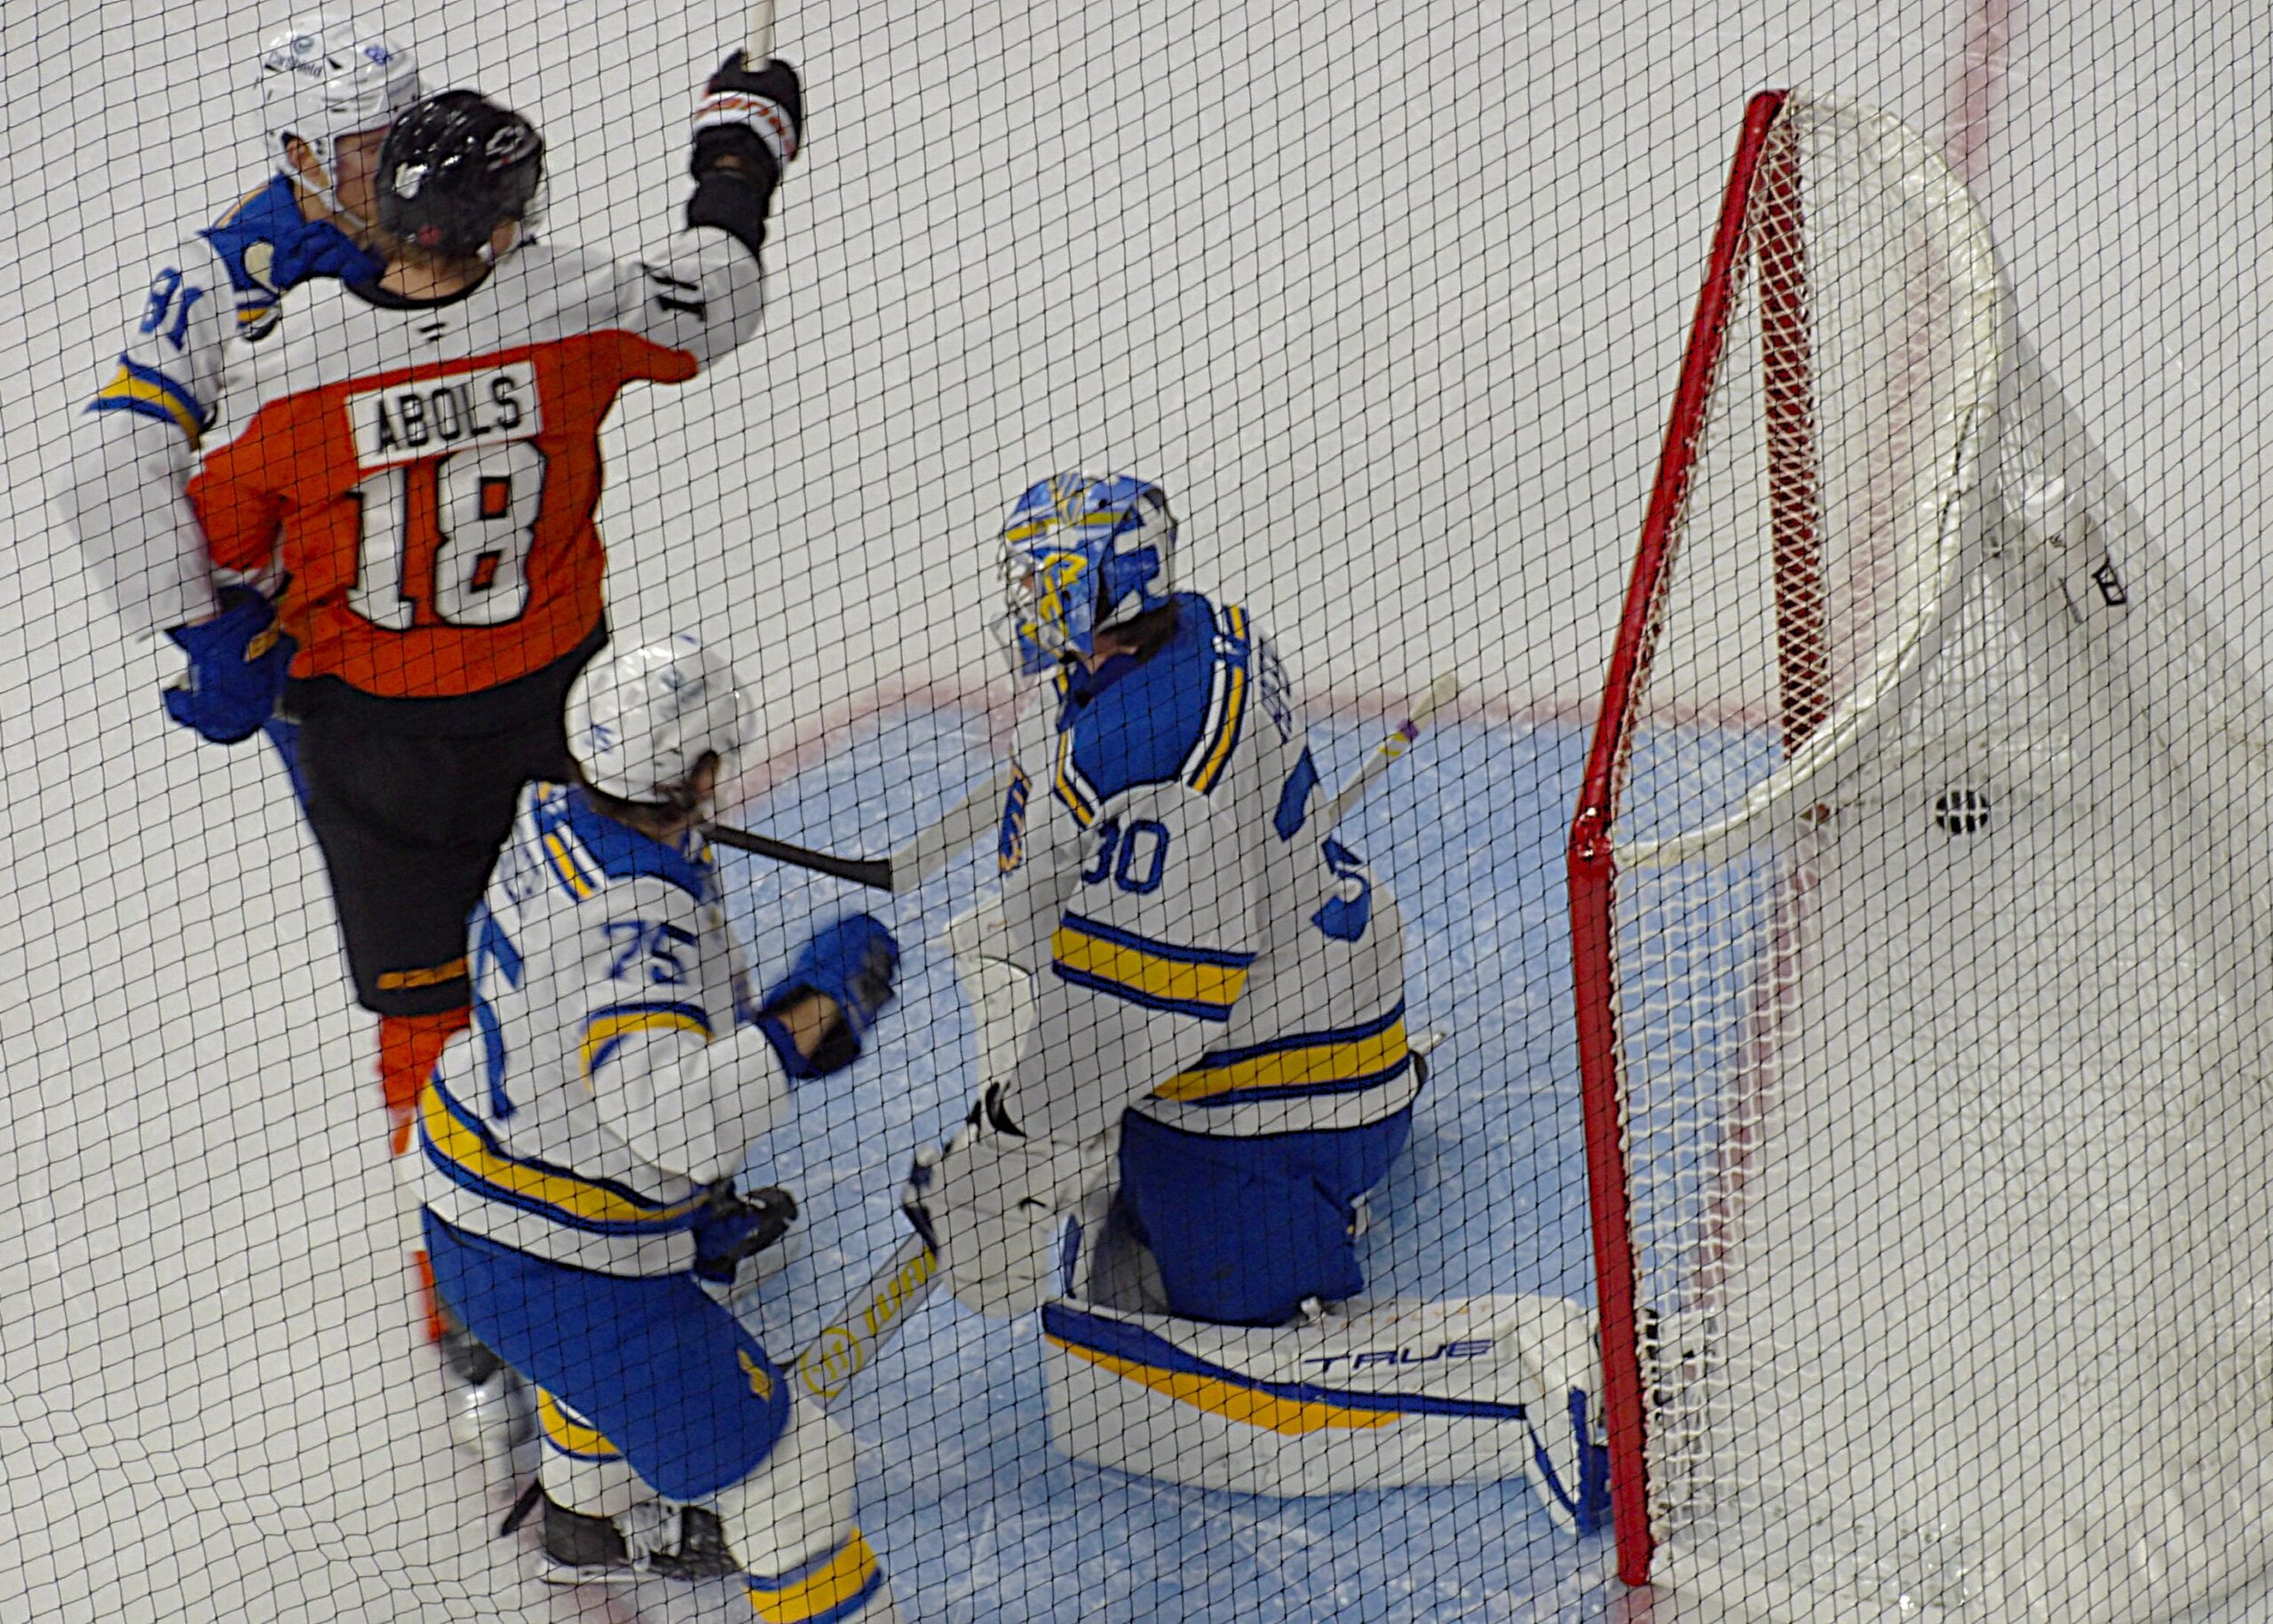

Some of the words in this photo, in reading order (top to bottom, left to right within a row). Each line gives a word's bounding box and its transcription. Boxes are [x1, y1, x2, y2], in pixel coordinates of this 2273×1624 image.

[377, 376, 521, 454] ABOLS
[345, 440, 547, 633] 18
[1081, 818, 1170, 895] 30
[601, 920, 698, 985] 75
[1304, 1340, 1492, 1373] TRUE
